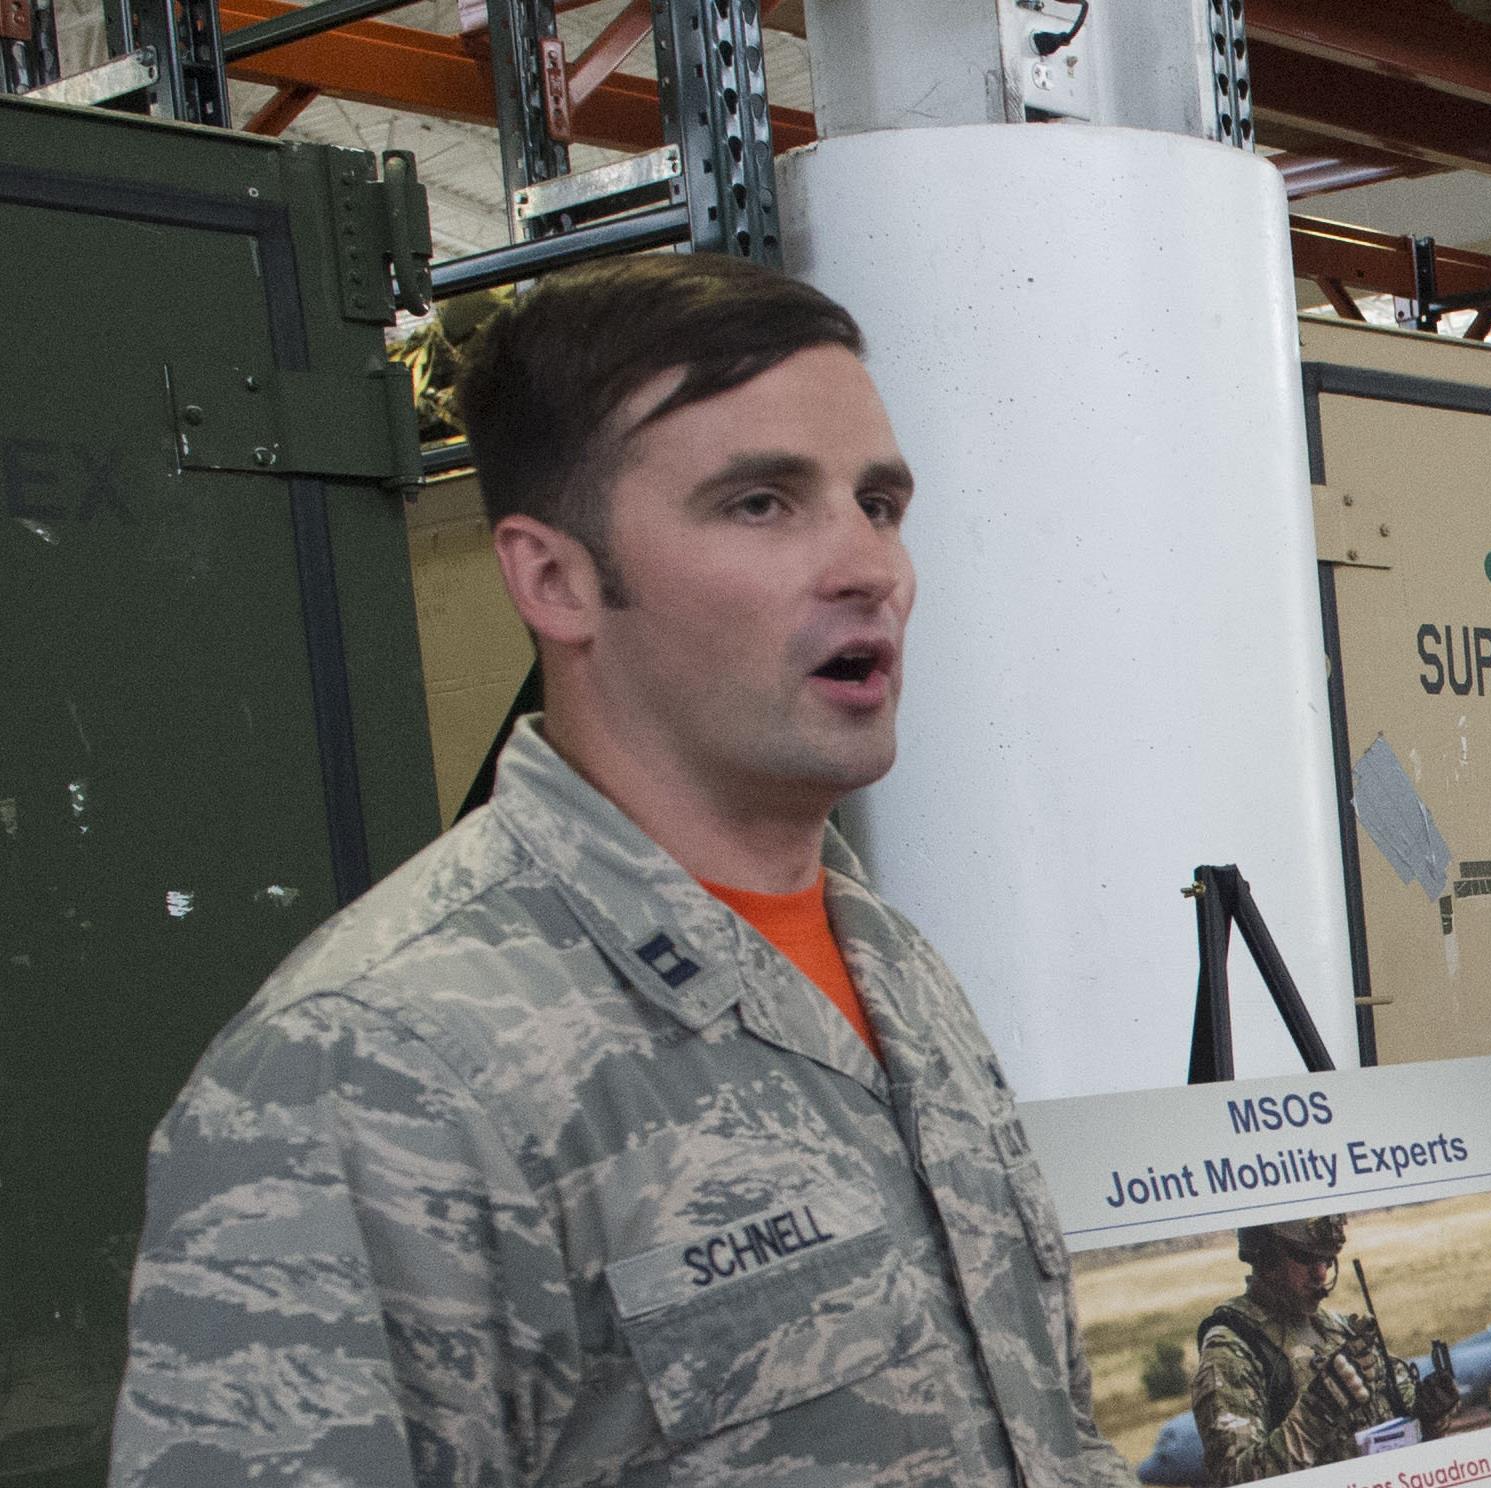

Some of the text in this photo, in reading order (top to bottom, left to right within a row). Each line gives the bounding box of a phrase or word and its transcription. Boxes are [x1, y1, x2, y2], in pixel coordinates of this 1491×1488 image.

[1227, 1091, 1333, 1134] MSOS
[1106, 1132, 1468, 1208] Joint Mobility Experts
[683, 1205, 834, 1286] SCHNELL
